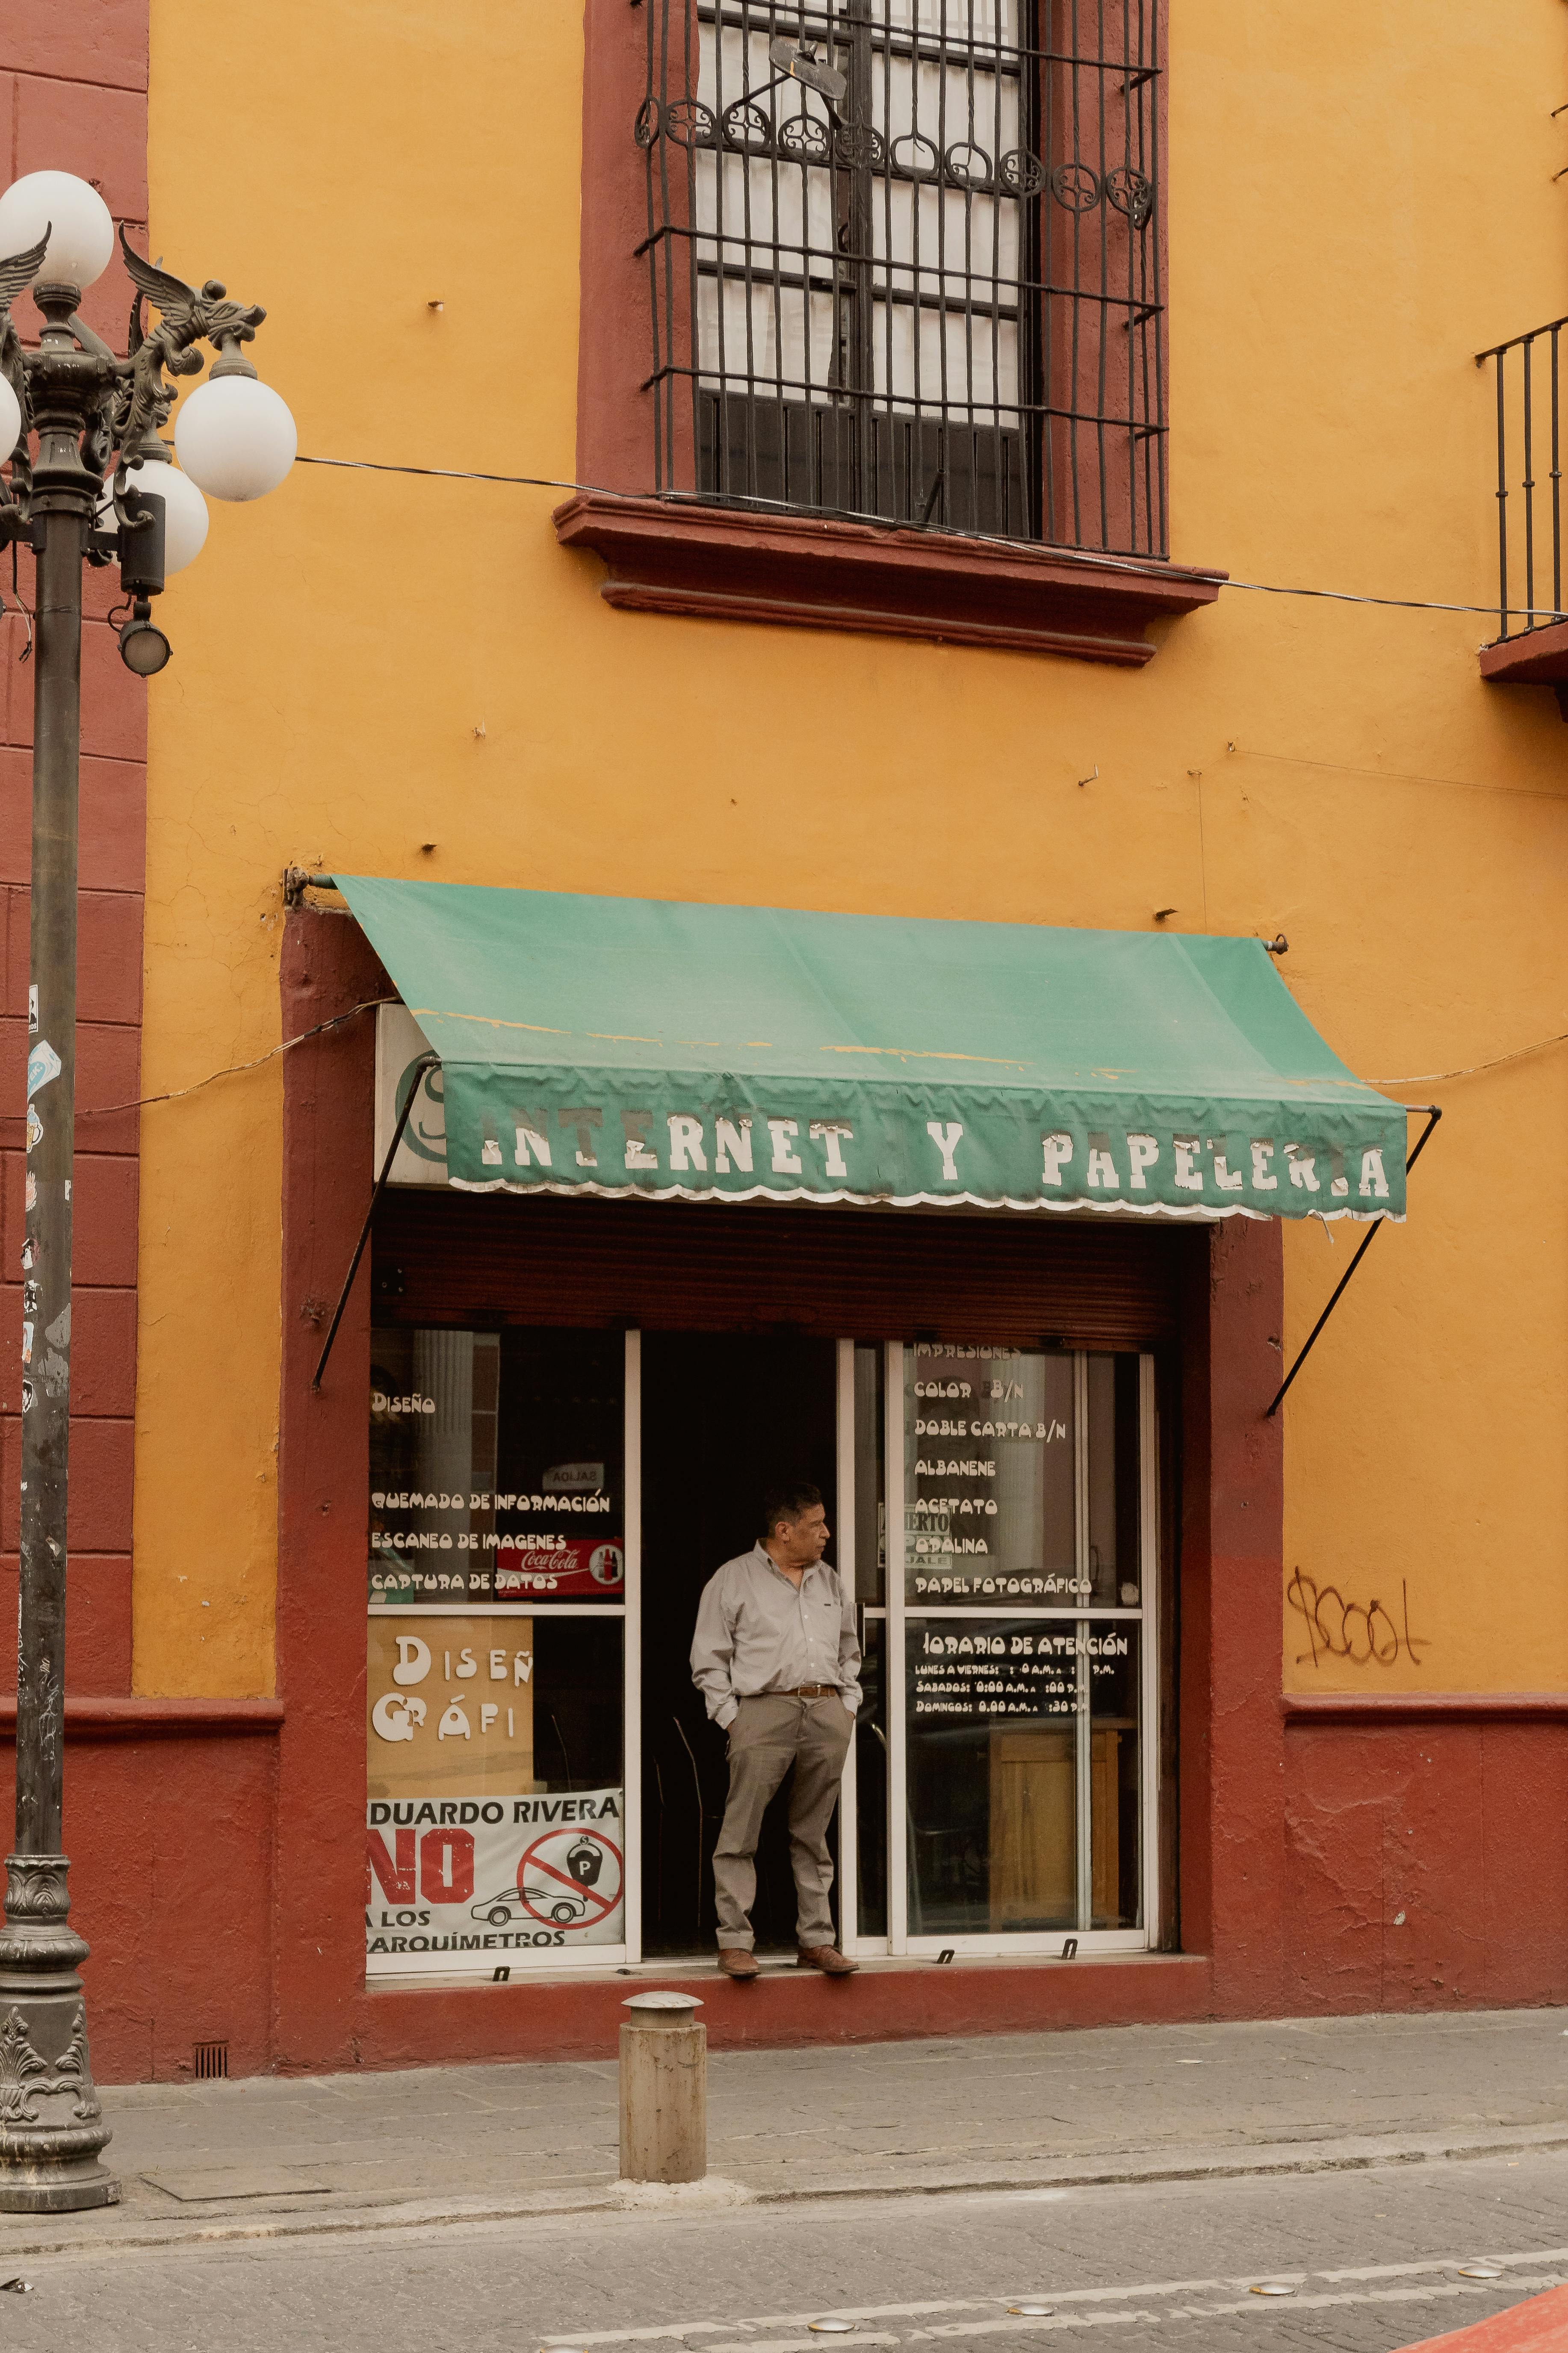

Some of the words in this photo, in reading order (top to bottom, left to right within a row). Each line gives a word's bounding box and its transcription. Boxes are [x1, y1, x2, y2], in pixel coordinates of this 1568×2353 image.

[927, 1122, 963, 1180] Y
[913, 1342, 1021, 1359] IMPRESIONES
[914, 1381, 972, 1398] COLOR
[990, 1379, 1023, 1403] B/N
[372, 1392, 436, 1414] DISEÑO
[914, 1419, 967, 1436] DOBLE
[971, 1420, 1033, 1438] CARTA
[1035, 1419, 1066, 1443] B/N
[914, 1459, 996, 1477] ALBANENE
[372, 1492, 465, 1509] QUEMADO
[469, 1494, 490, 1510] DE
[494, 1489, 611, 1512] INFORMACIÓN
[915, 1498, 998, 1515] ACETATO
[372, 1532, 453, 1549] ESCANEO
[457, 1533, 478, 1549] DE
[482, 1534, 566, 1550] IMAGENES
[915, 1538, 988, 1554] OPALINA
[372, 1574, 464, 1590] CAPTURA
[469, 1574, 490, 1589] DE
[495, 1574, 558, 1589] DATOS
[915, 1577, 969, 1593] PAPEL
[974, 1573, 1092, 1594] FOTOGRÁFICO
[1011, 1637, 1033, 1655] DE
[1038, 1633, 1128, 1656] ATENCIÓN
[915, 1665, 945, 1675] LUNES
[947, 1665, 955, 1674] A
[957, 1665, 999, 1675] VIERNES:
[1031, 1665, 1054, 1674] A.M.
[1093, 1665, 1114, 1674] P.M.
[916, 1680, 970, 1692] SABADOS:
[1006, 1683, 1029, 1693] A.M.
[915, 1701, 972, 1712] DOMINGOS:
[1008, 1703, 1031, 1712] A.M.
[370, 1802, 504, 1825] DUARDO
[513, 1797, 619, 1823] RIVERA
[366, 1828, 475, 1904] NO
[381, 1910, 431, 1927] LOS
[366, 1931, 565, 1952] ARQUÍMETROS
